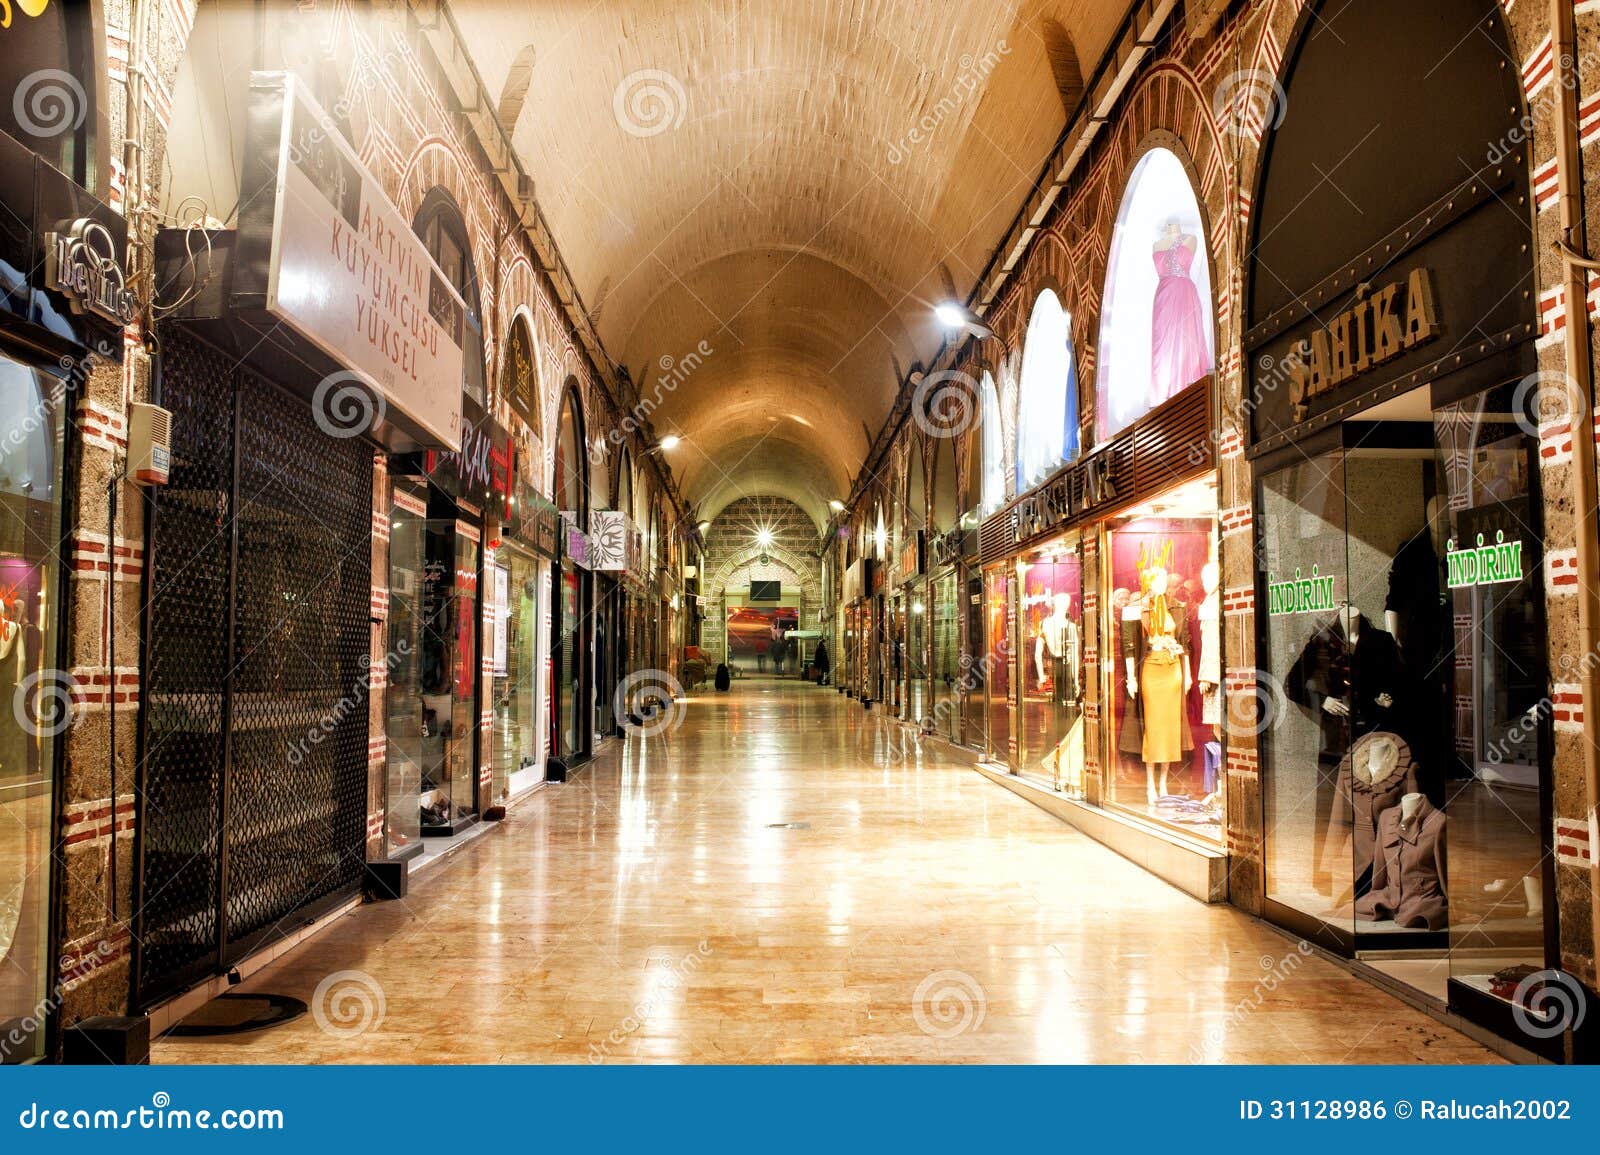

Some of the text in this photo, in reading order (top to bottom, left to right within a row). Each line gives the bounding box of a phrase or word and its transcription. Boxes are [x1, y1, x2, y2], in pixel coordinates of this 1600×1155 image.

[331, 216, 438, 359] KUYUMCUSU
[361, 202, 423, 298] ARTVİN
[356, 294, 417, 381] YÜKSEL
[1289, 267, 1440, 422] ŞAHİKA
[1269, 564, 1335, 614] İNDİRİM
[1447, 529, 1523, 588] İNDİRİM
